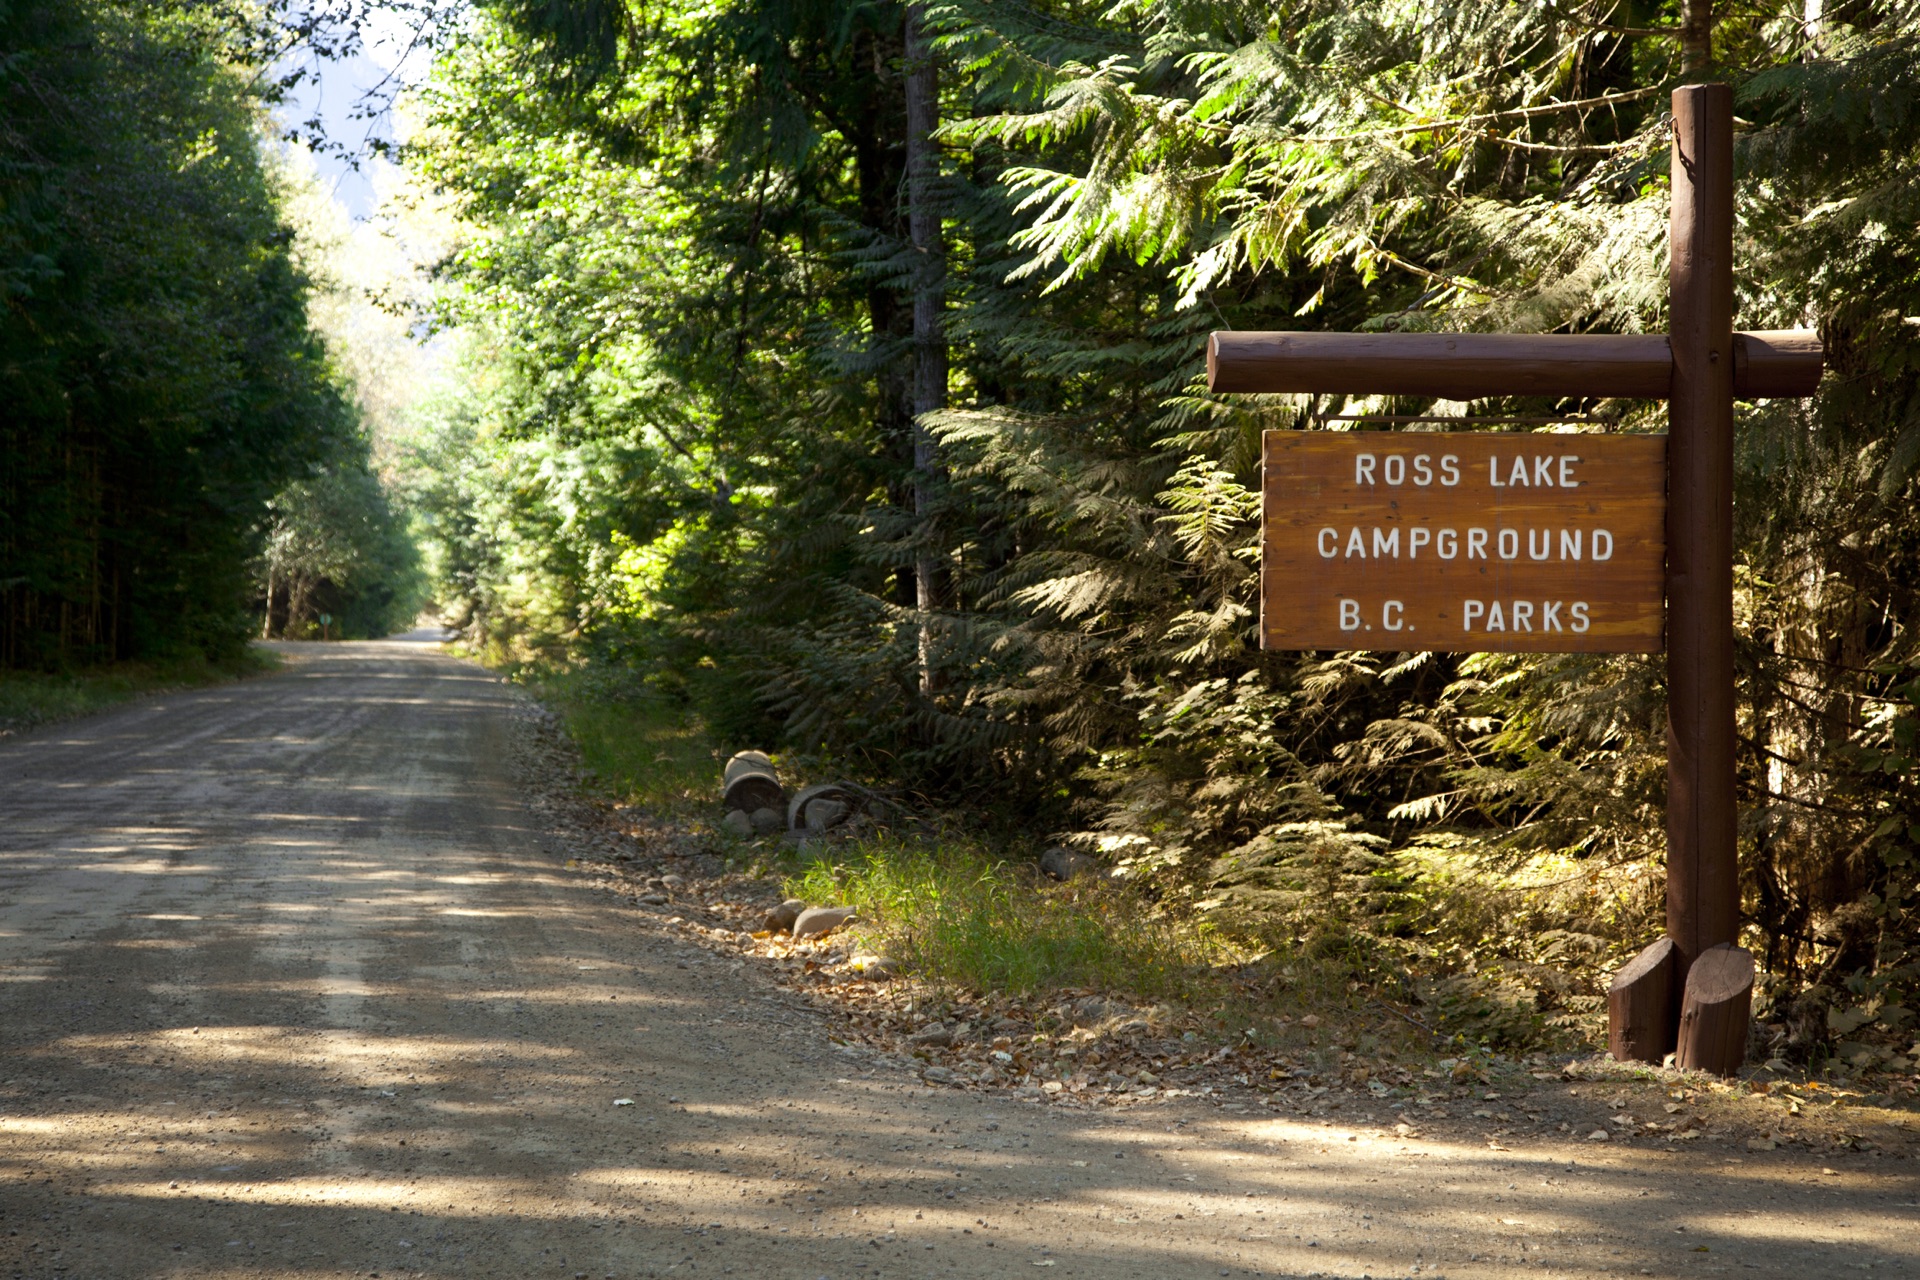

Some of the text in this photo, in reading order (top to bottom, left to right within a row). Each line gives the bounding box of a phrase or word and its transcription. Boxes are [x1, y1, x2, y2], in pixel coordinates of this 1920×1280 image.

[1355, 453, 1580, 488] ROSS LAKE
[1317, 526, 1615, 561] CAMPGROUND
[1463, 599, 1591, 633] PARKS
